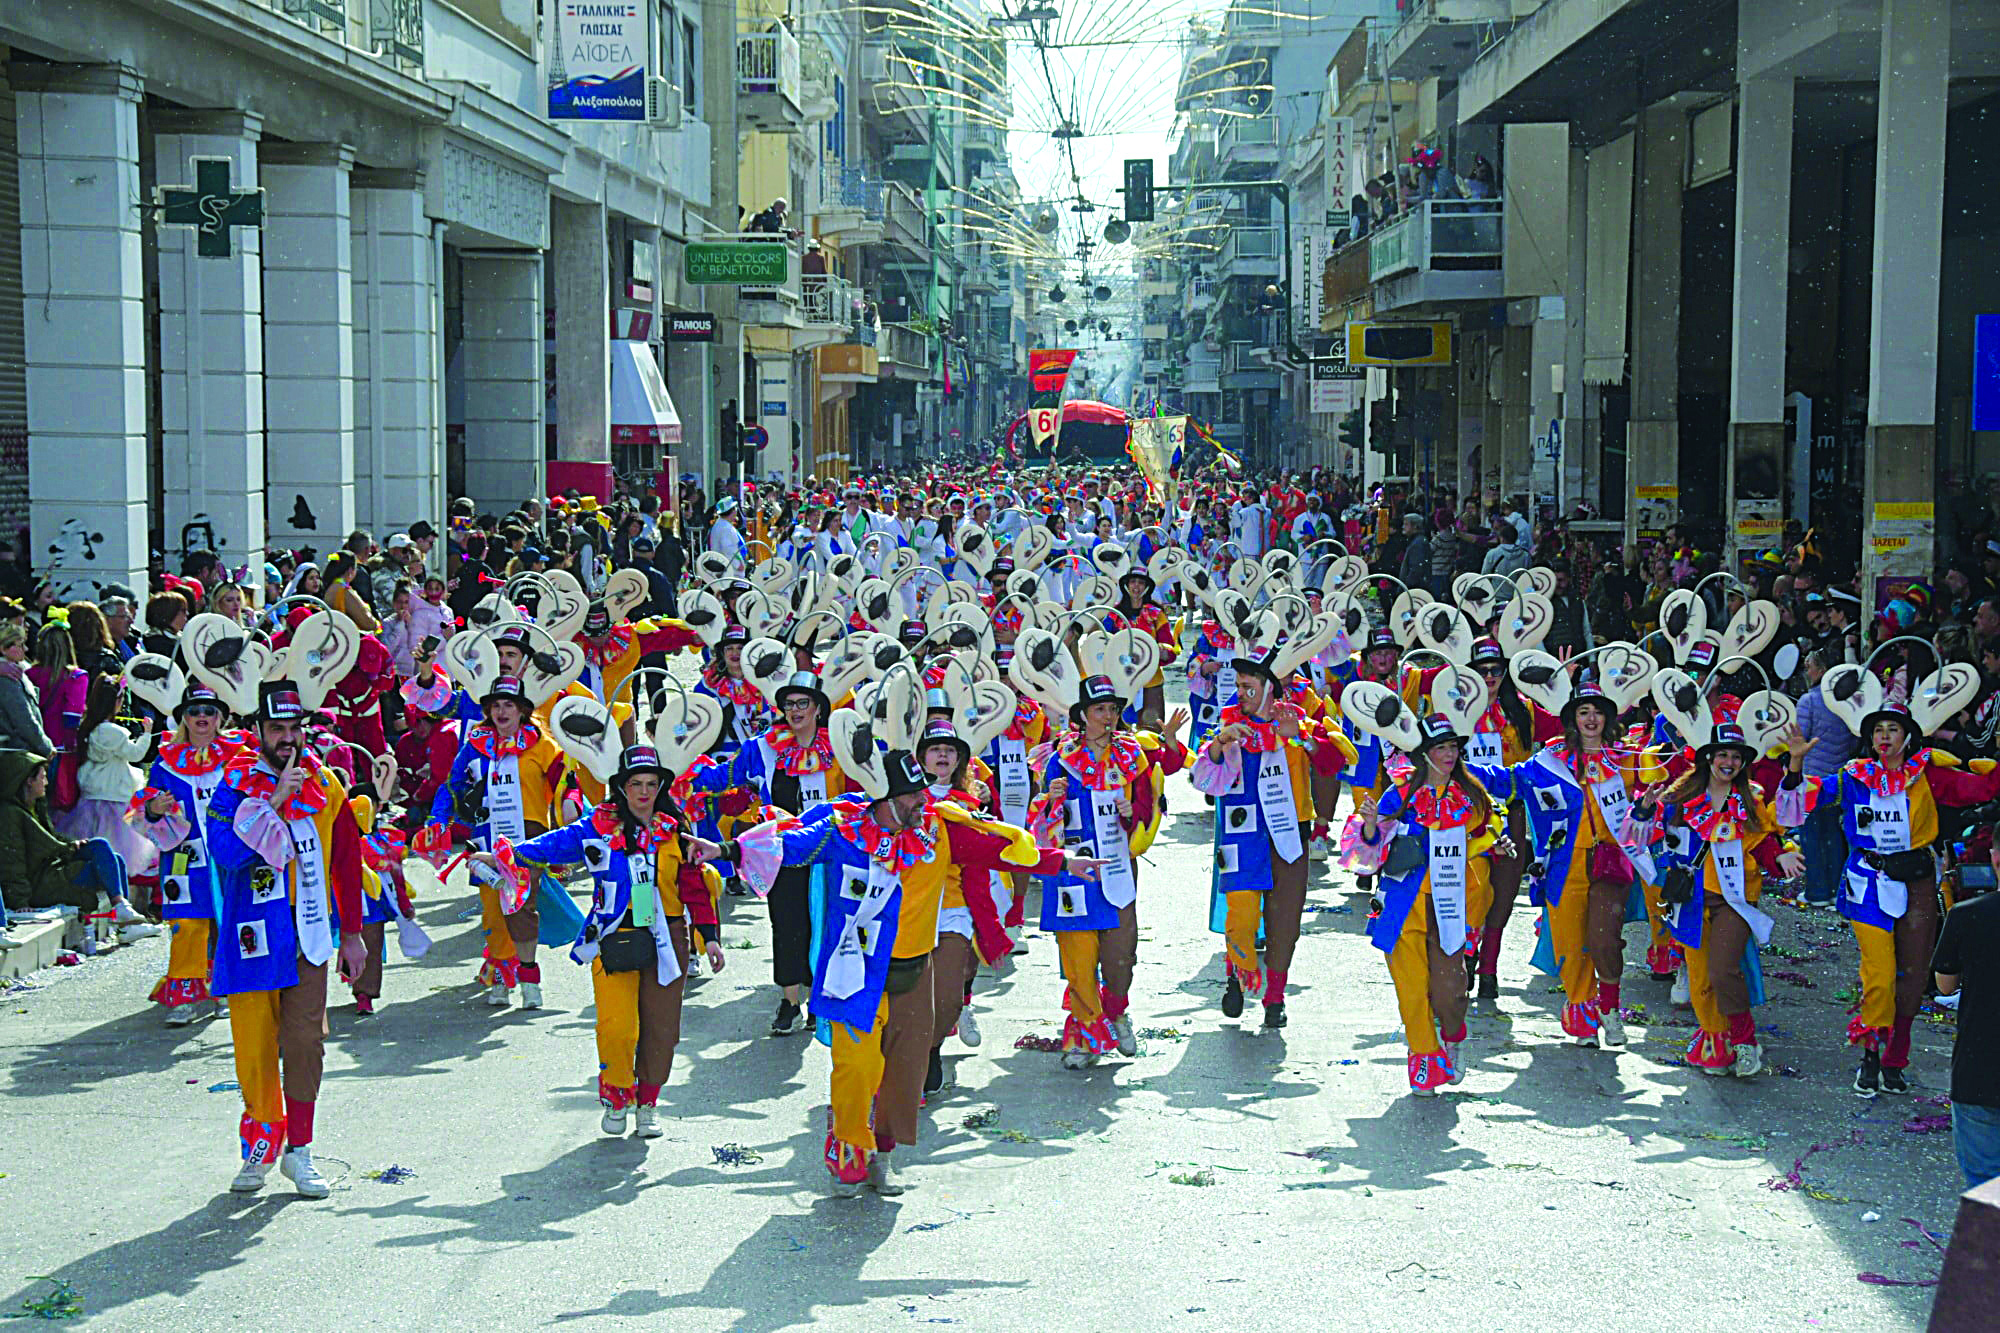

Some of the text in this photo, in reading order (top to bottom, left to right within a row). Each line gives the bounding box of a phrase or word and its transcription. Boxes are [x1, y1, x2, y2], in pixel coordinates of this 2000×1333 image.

[576, 5, 626, 17] ΓΑΛΛΙΚΗΣ
[580, 23, 623, 36] ΓΛΩΣΣΑΣ
[572, 43, 633, 63] ΑΪΦΕΛ
[572, 95, 643, 110] Αλεξοπούλου
[1332, 122, 1345, 209] ΙΤΑΛΙΚΑ
[690, 252, 782, 265] UNITED COLORS
[690, 264, 707, 276] OF
[673, 320, 711, 331] FAMOUS
[1473, 746, 1498, 757] Κ.Υ.Π.
[1874, 810, 1904, 823] Κ.Υ.Π.
[1434, 845, 1462, 858] Κ.Υ.Π.
[249, 1140, 268, 1165] REC
